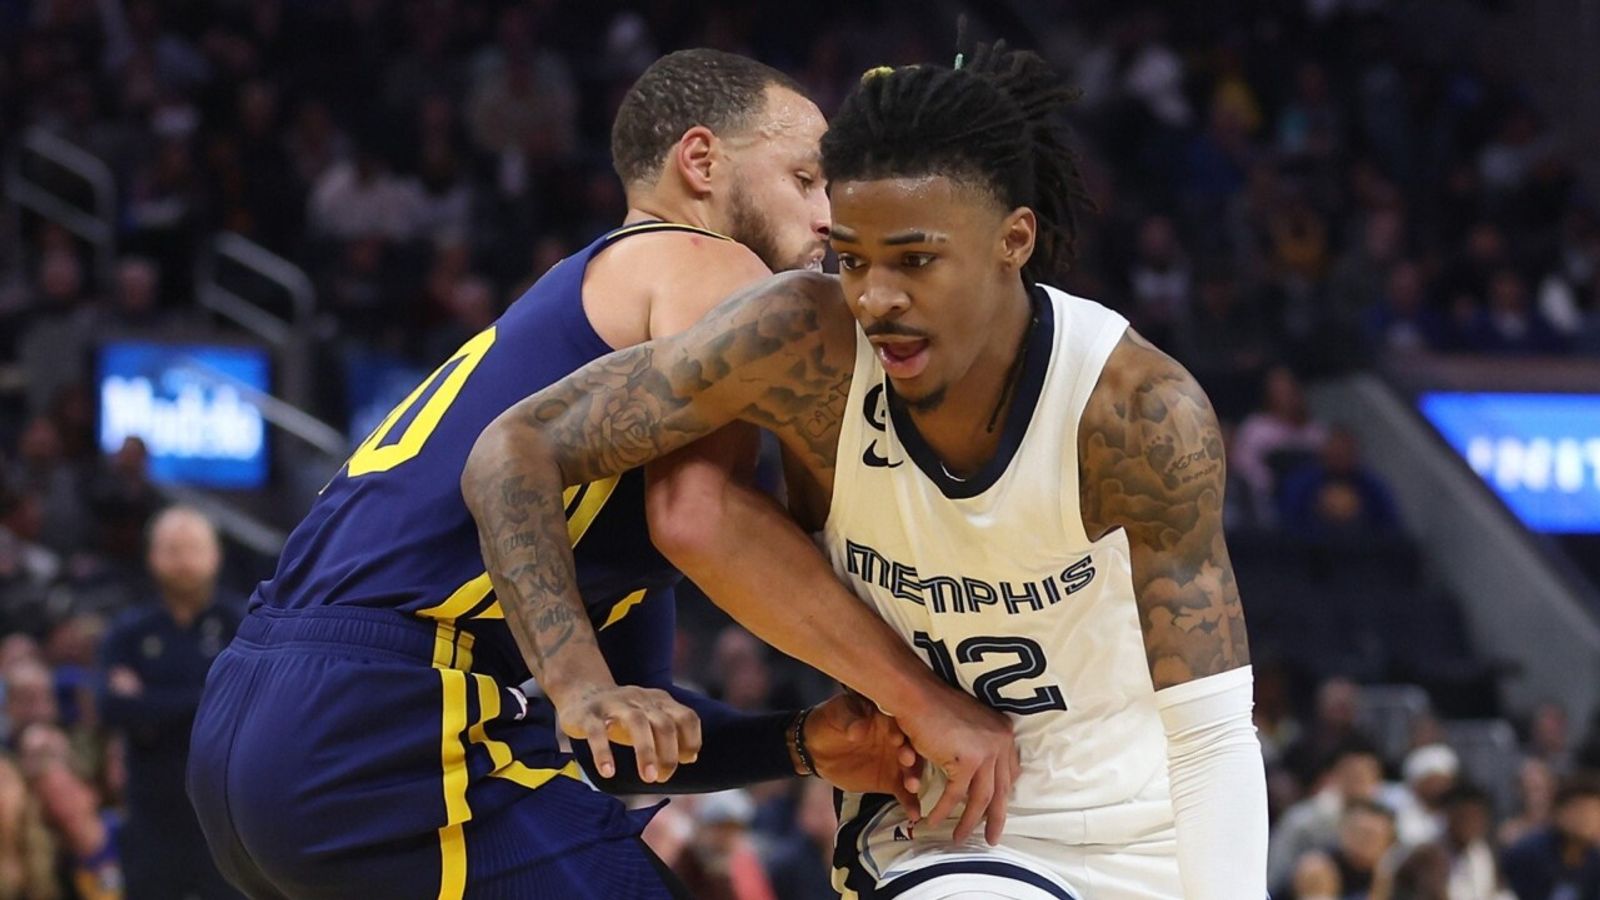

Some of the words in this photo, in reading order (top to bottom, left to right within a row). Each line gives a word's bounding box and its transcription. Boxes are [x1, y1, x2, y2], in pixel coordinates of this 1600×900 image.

[346, 325, 497, 478] 0
[846, 539, 1096, 615] MEMPHIS
[913, 631, 1067, 716] 12
